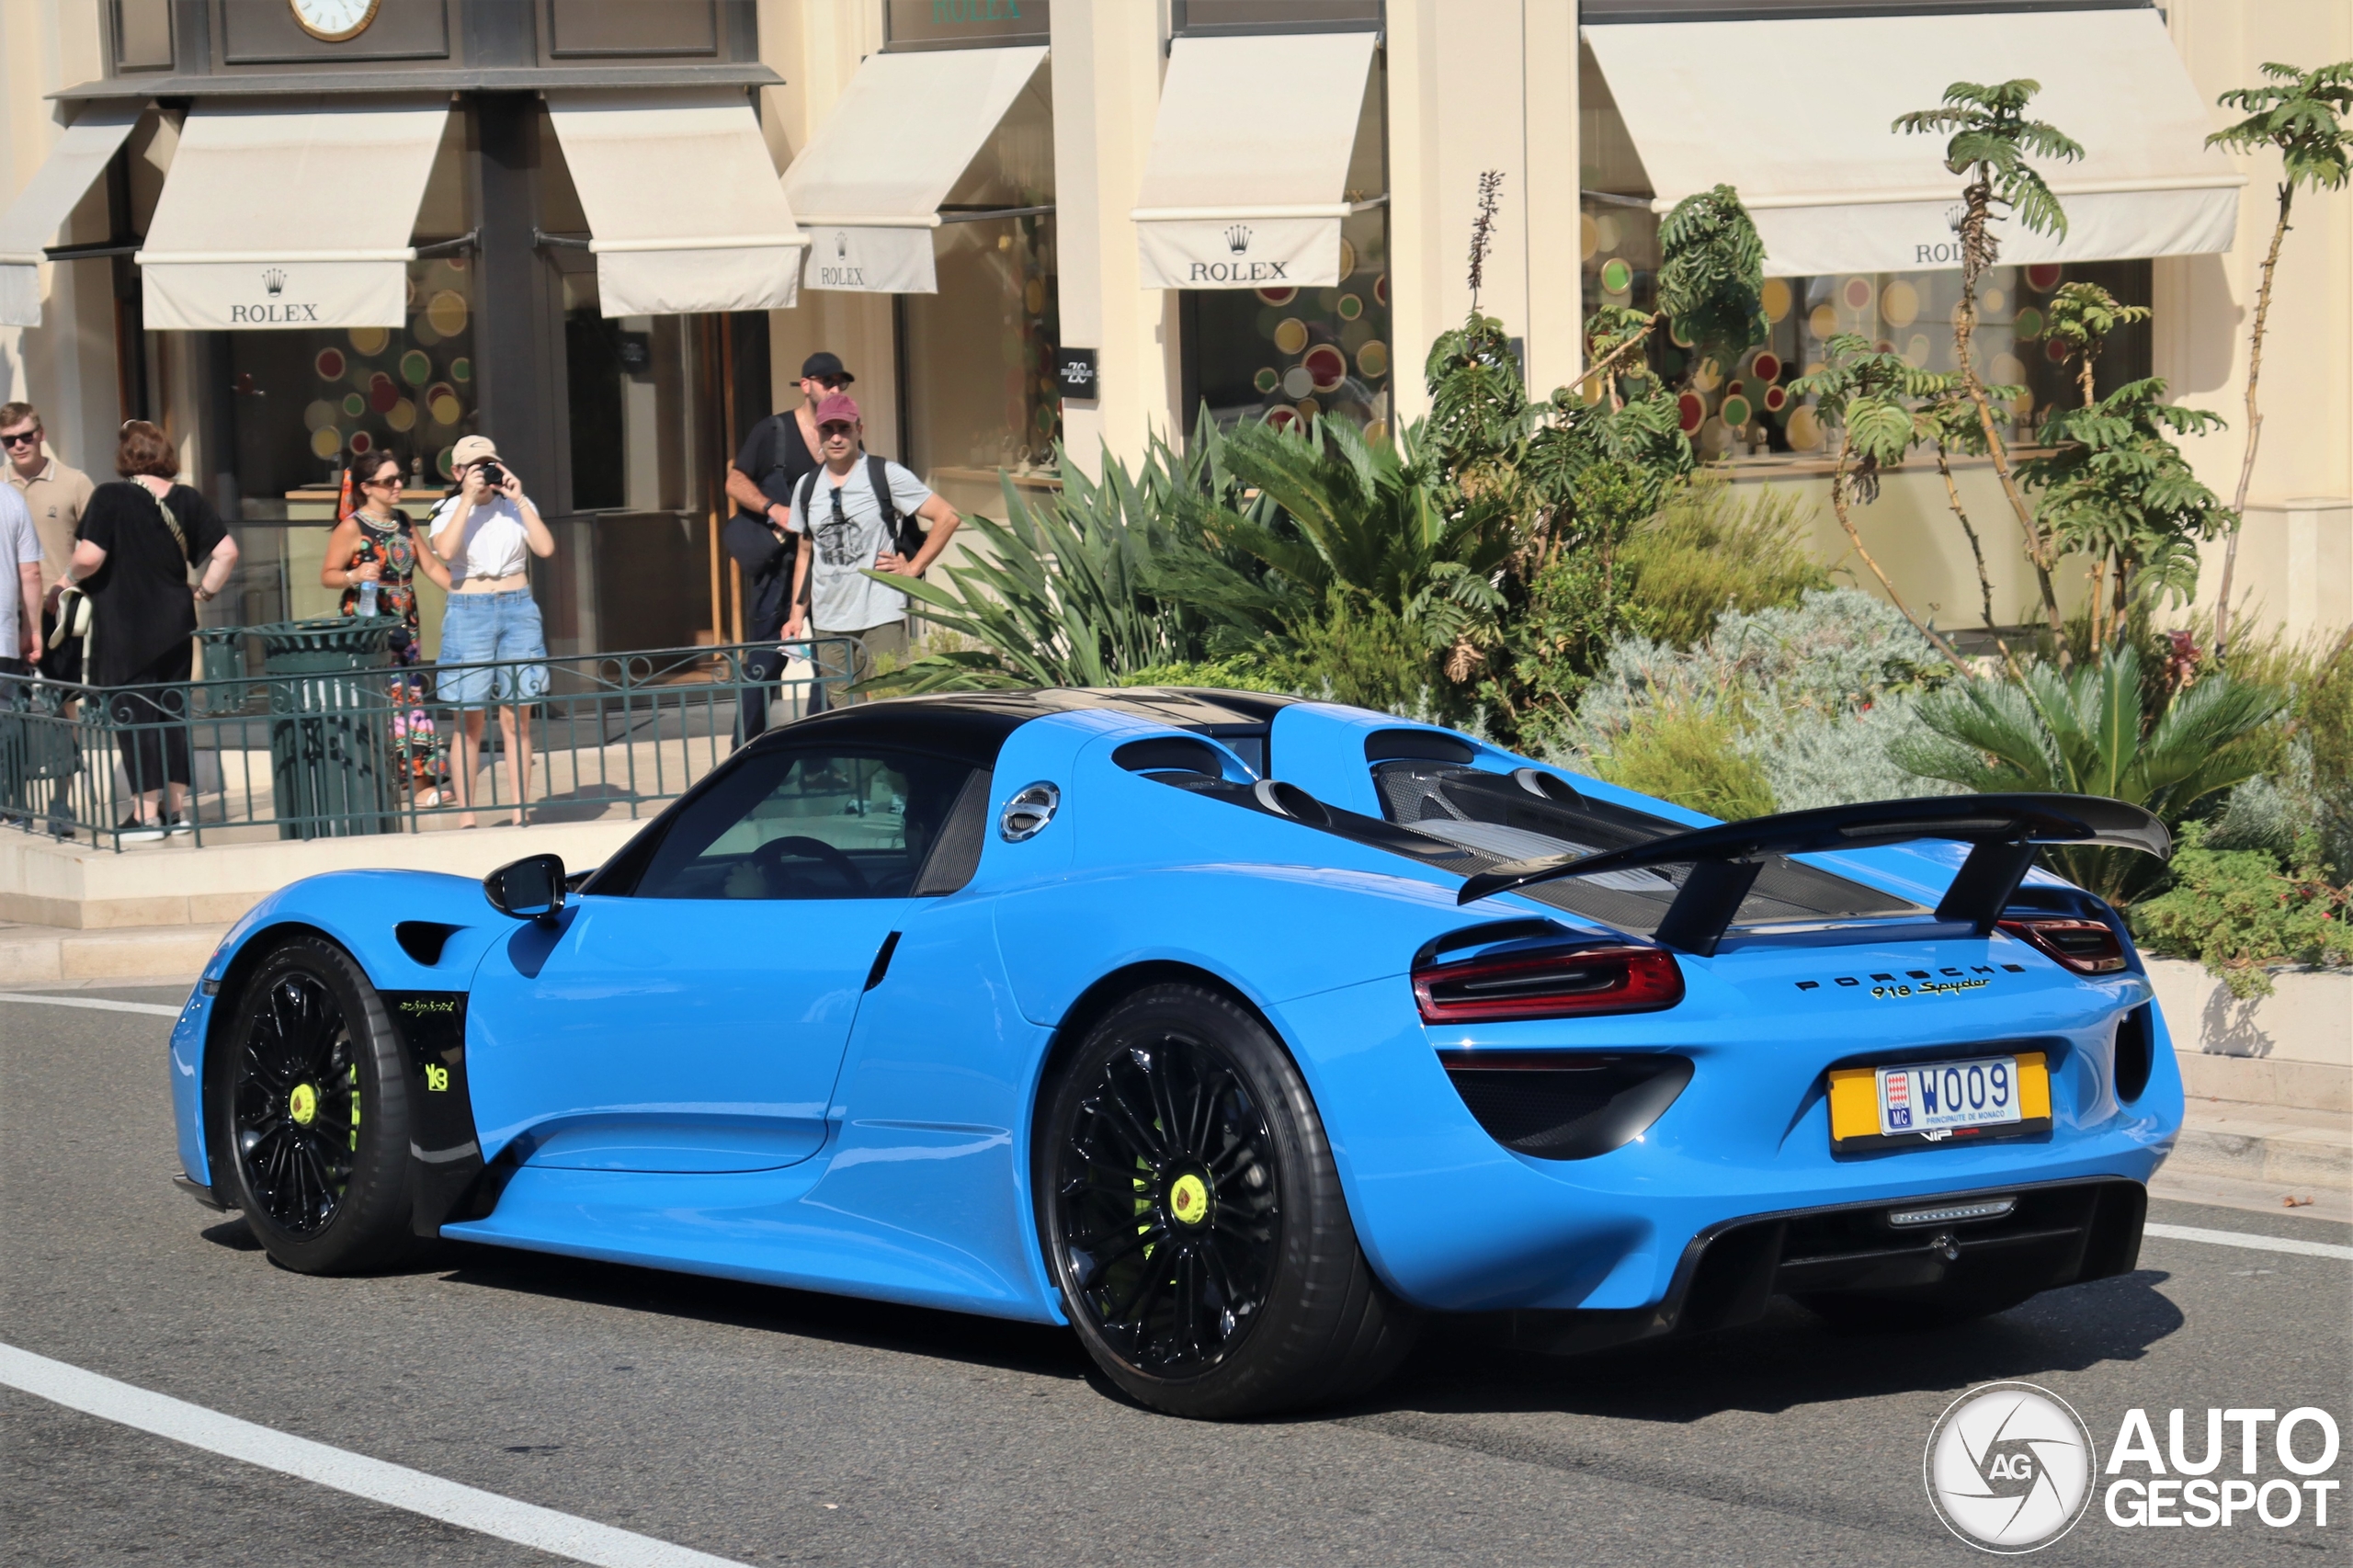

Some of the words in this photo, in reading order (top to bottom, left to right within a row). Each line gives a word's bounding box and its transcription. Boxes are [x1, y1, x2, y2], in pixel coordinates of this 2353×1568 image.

[821, 267, 865, 286] ROLEX
[1188, 261, 1289, 281] ROLEX
[230, 303, 318, 323] ROLEX
[1795, 964, 2026, 991] PORSCHE
[1870, 985, 1912, 999] 918
[1916, 977, 1991, 996] Spyder
[1918, 1062, 2009, 1115] W009
[1893, 1109, 1908, 1126] MC
[1926, 1114, 1966, 1125] PRINCIPAUTE
[1968, 1112, 1977, 1120] DE
[1978, 1109, 2006, 1119] MONACO
[1920, 1129, 1953, 1142] VIP
